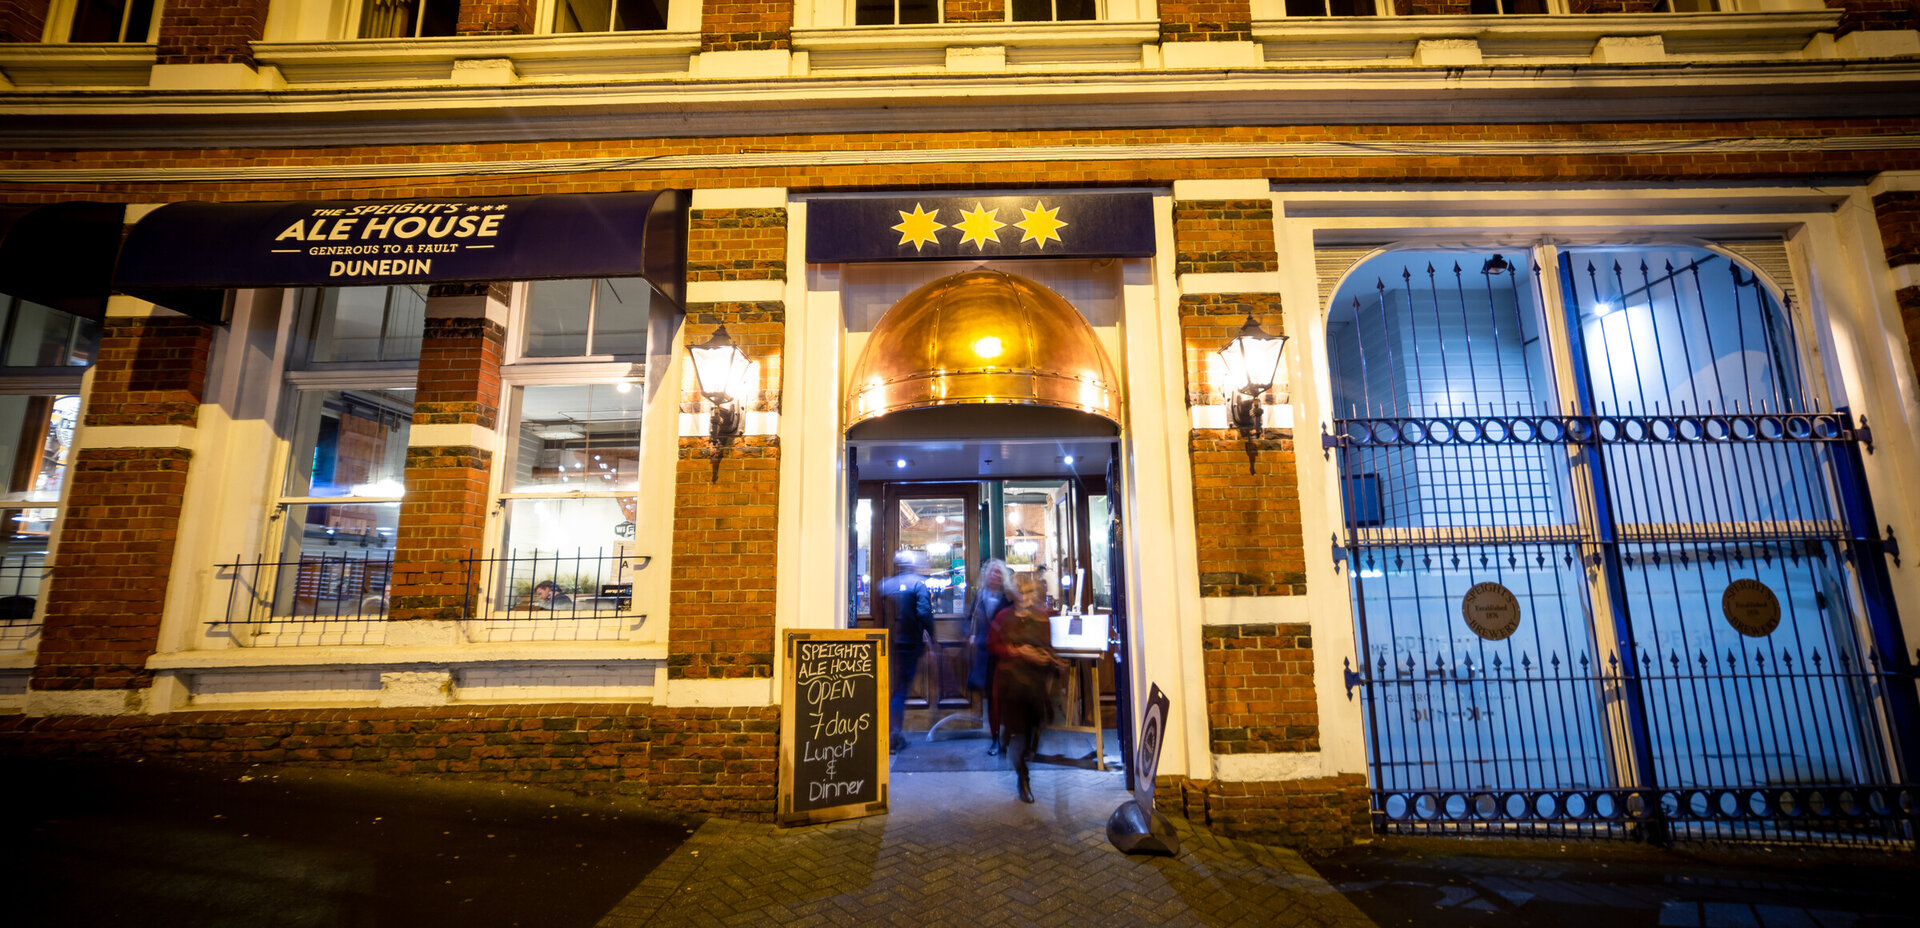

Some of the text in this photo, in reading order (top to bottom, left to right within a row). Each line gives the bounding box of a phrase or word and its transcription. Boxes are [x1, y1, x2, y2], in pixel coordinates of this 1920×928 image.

[311, 203, 465, 217] THE SPEIGHT'S
[274, 214, 505, 241] ALE HOUSE
[309, 243, 459, 256] GENEROUS TO A FAULT
[329, 259, 432, 277] DUNEDIN
[1469, 618, 1517, 638] BREWERY
[801, 644, 871, 660] SPEIGHTS
[799, 659, 872, 678] ALE HOUSE
[807, 680, 856, 713] OPEN
[809, 711, 870, 746] 7 days
[825, 757, 837, 780] &
[809, 778, 864, 802] Dinner
